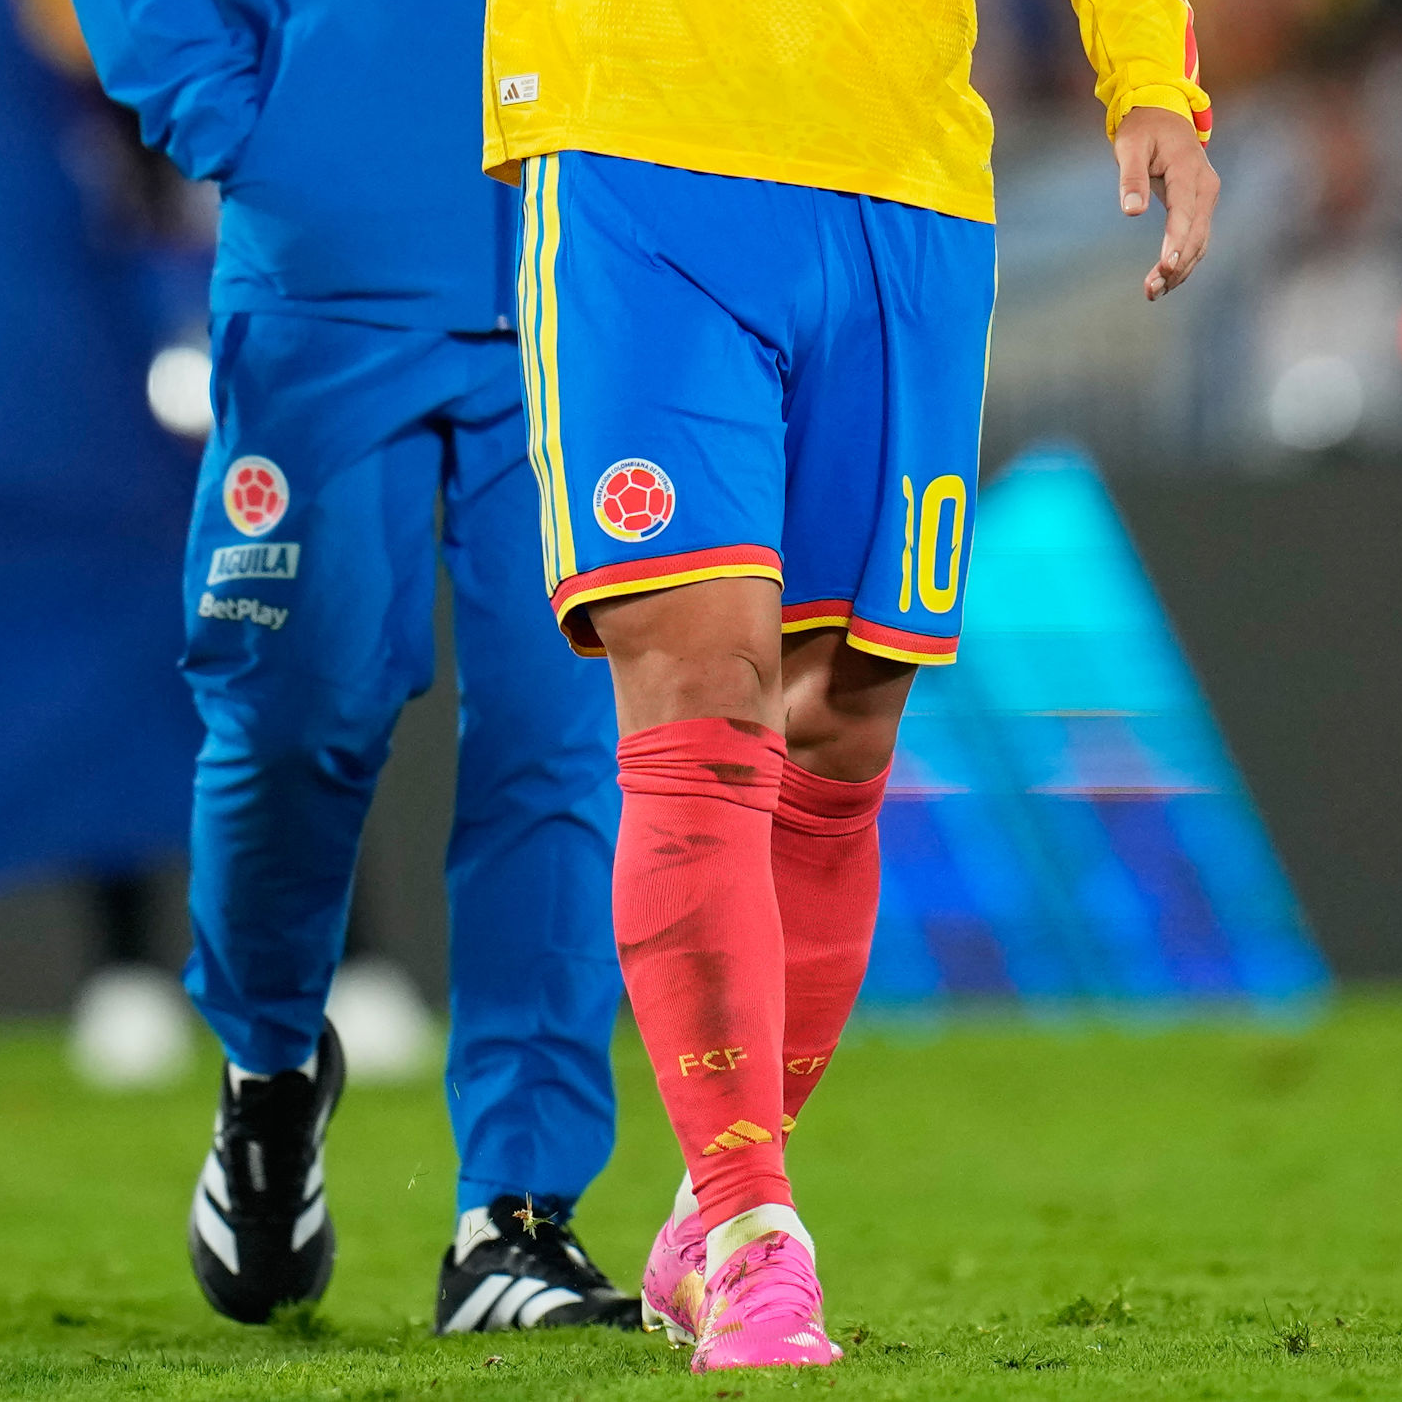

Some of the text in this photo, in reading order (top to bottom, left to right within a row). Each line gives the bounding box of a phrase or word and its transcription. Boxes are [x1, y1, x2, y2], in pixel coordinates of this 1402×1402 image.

[898, 474, 967, 615] 10
[199, 591, 289, 631] BetPlay
[678, 1047, 748, 1077] FCF
